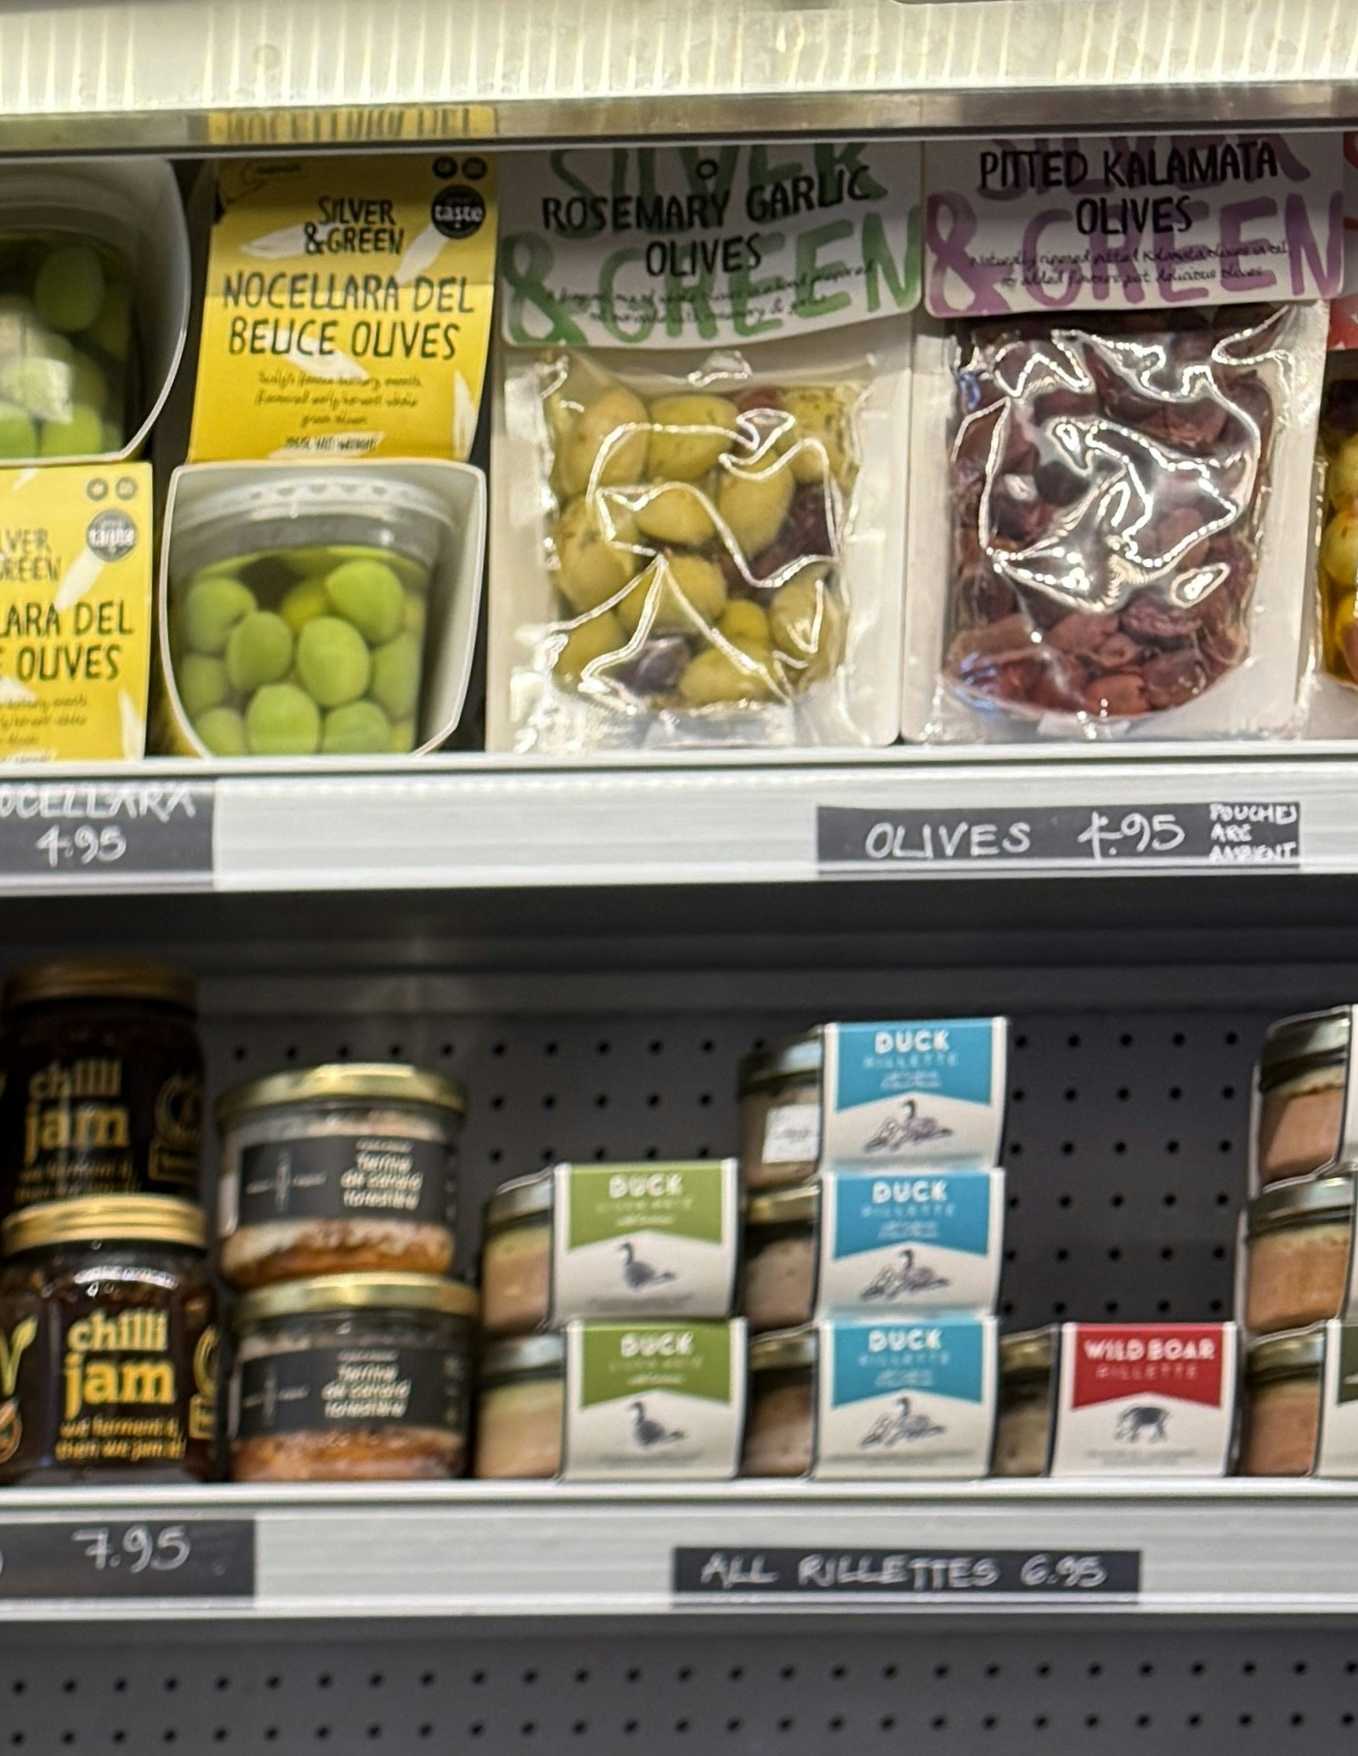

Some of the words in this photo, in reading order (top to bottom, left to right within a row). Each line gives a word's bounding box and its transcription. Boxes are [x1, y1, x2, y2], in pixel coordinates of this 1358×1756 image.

[980, 150, 1087, 190] PITTED
[1104, 141, 1278, 188] KALAMATA
[317, 197, 397, 226] SILVER
[434, 203, 484, 223] taste
[542, 190, 732, 232] ROSEMARY
[746, 165, 874, 223] GARLIC
[1076, 196, 1193, 235] OLIVES
[645, 232, 762, 277] OLIVES
[222, 271, 399, 312] NOCELLARA
[414, 275, 474, 314] DEL
[74, 600, 133, 636] DEL
[35, 822, 129, 865] 4.95
[865, 821, 1031, 861] OLIVES
[1077, 811, 1186, 861] 4.95
[874, 1029, 951, 1056] DUCK
[25, 1105, 131, 1166] jam
[609, 1173, 683, 1199] DUCK
[872, 1180, 949, 1205] DUCK
[68, 1309, 169, 1353] chilli
[621, 1332, 695, 1358] DUCK
[868, 1328, 944, 1353] DUCK
[1083, 1338, 1145, 1363] WILD
[1146, 1337, 1217, 1362] BOAR
[64, 1352, 176, 1421] jam
[72, 1524, 193, 1574] 7.95
[699, 1552, 781, 1590] ALL
[796, 1553, 1002, 1590] RILLETTES
[1020, 1554, 1109, 1588] 6.95
